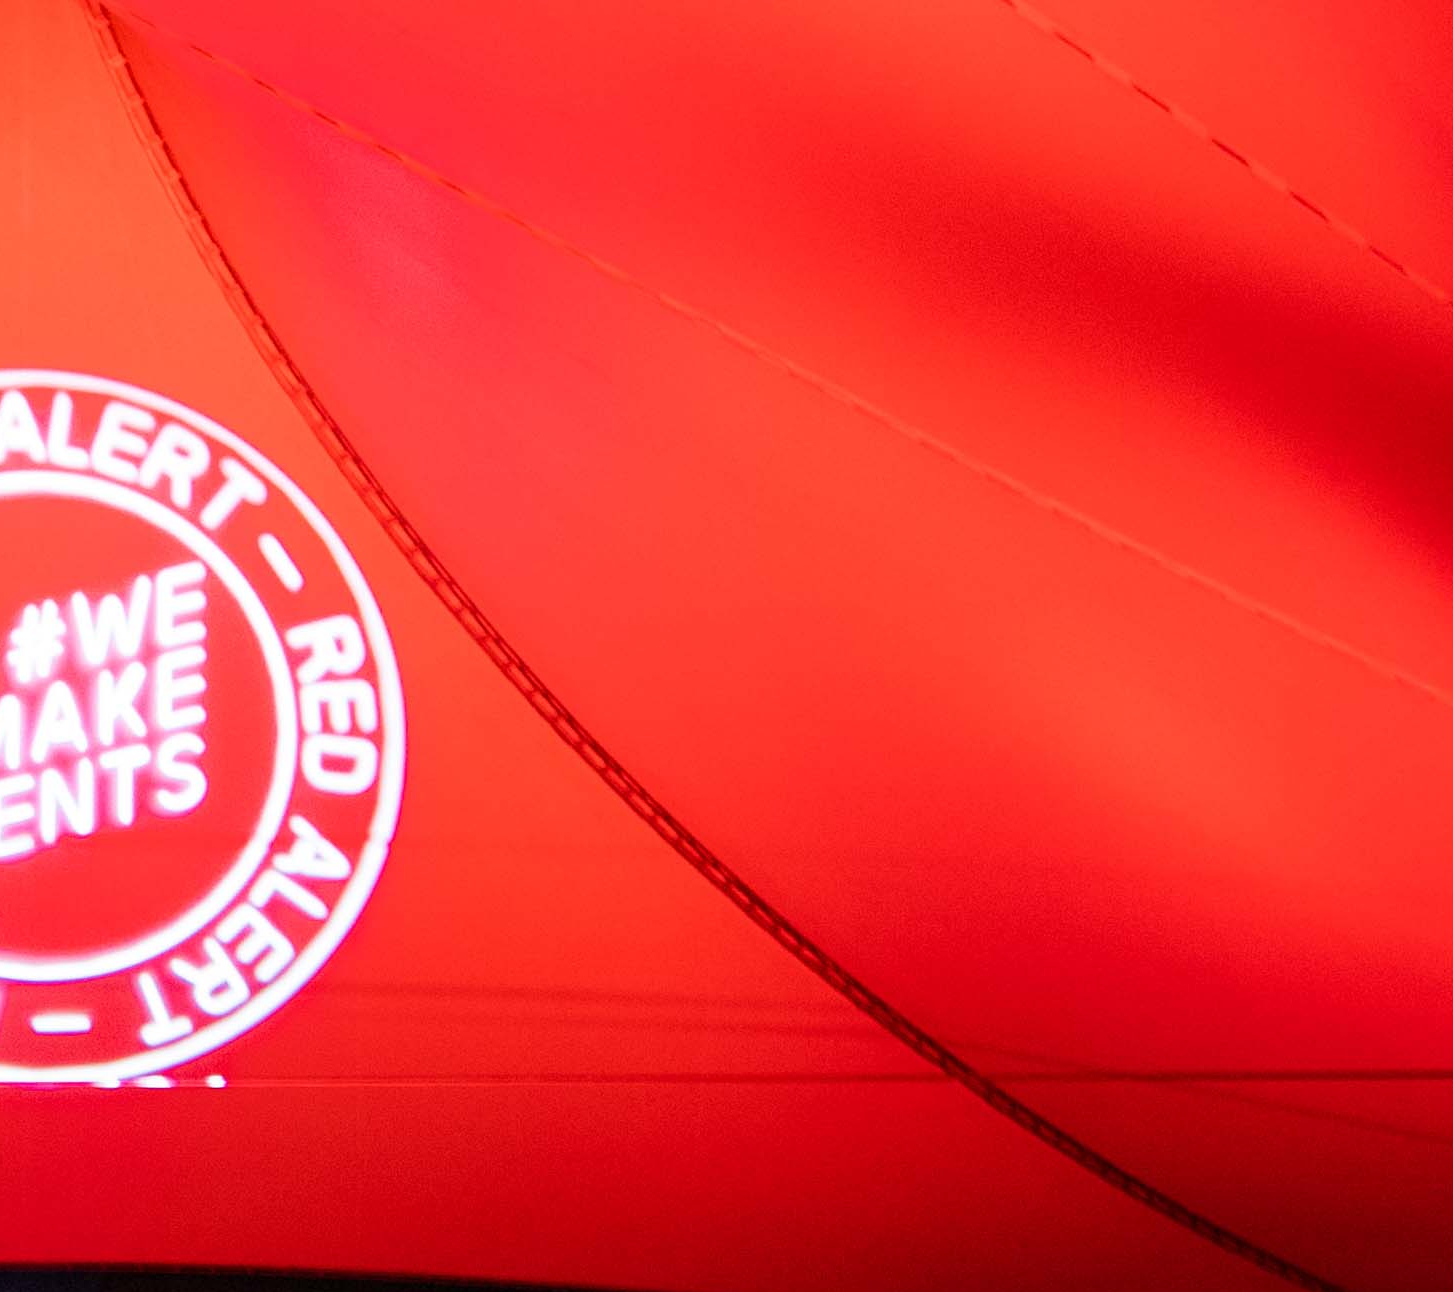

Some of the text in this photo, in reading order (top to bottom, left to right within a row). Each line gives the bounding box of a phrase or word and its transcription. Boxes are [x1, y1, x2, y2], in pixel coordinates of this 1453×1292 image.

[6, 561, 208, 685] #WE
[135, 613, 379, 1049] RED ALERT
